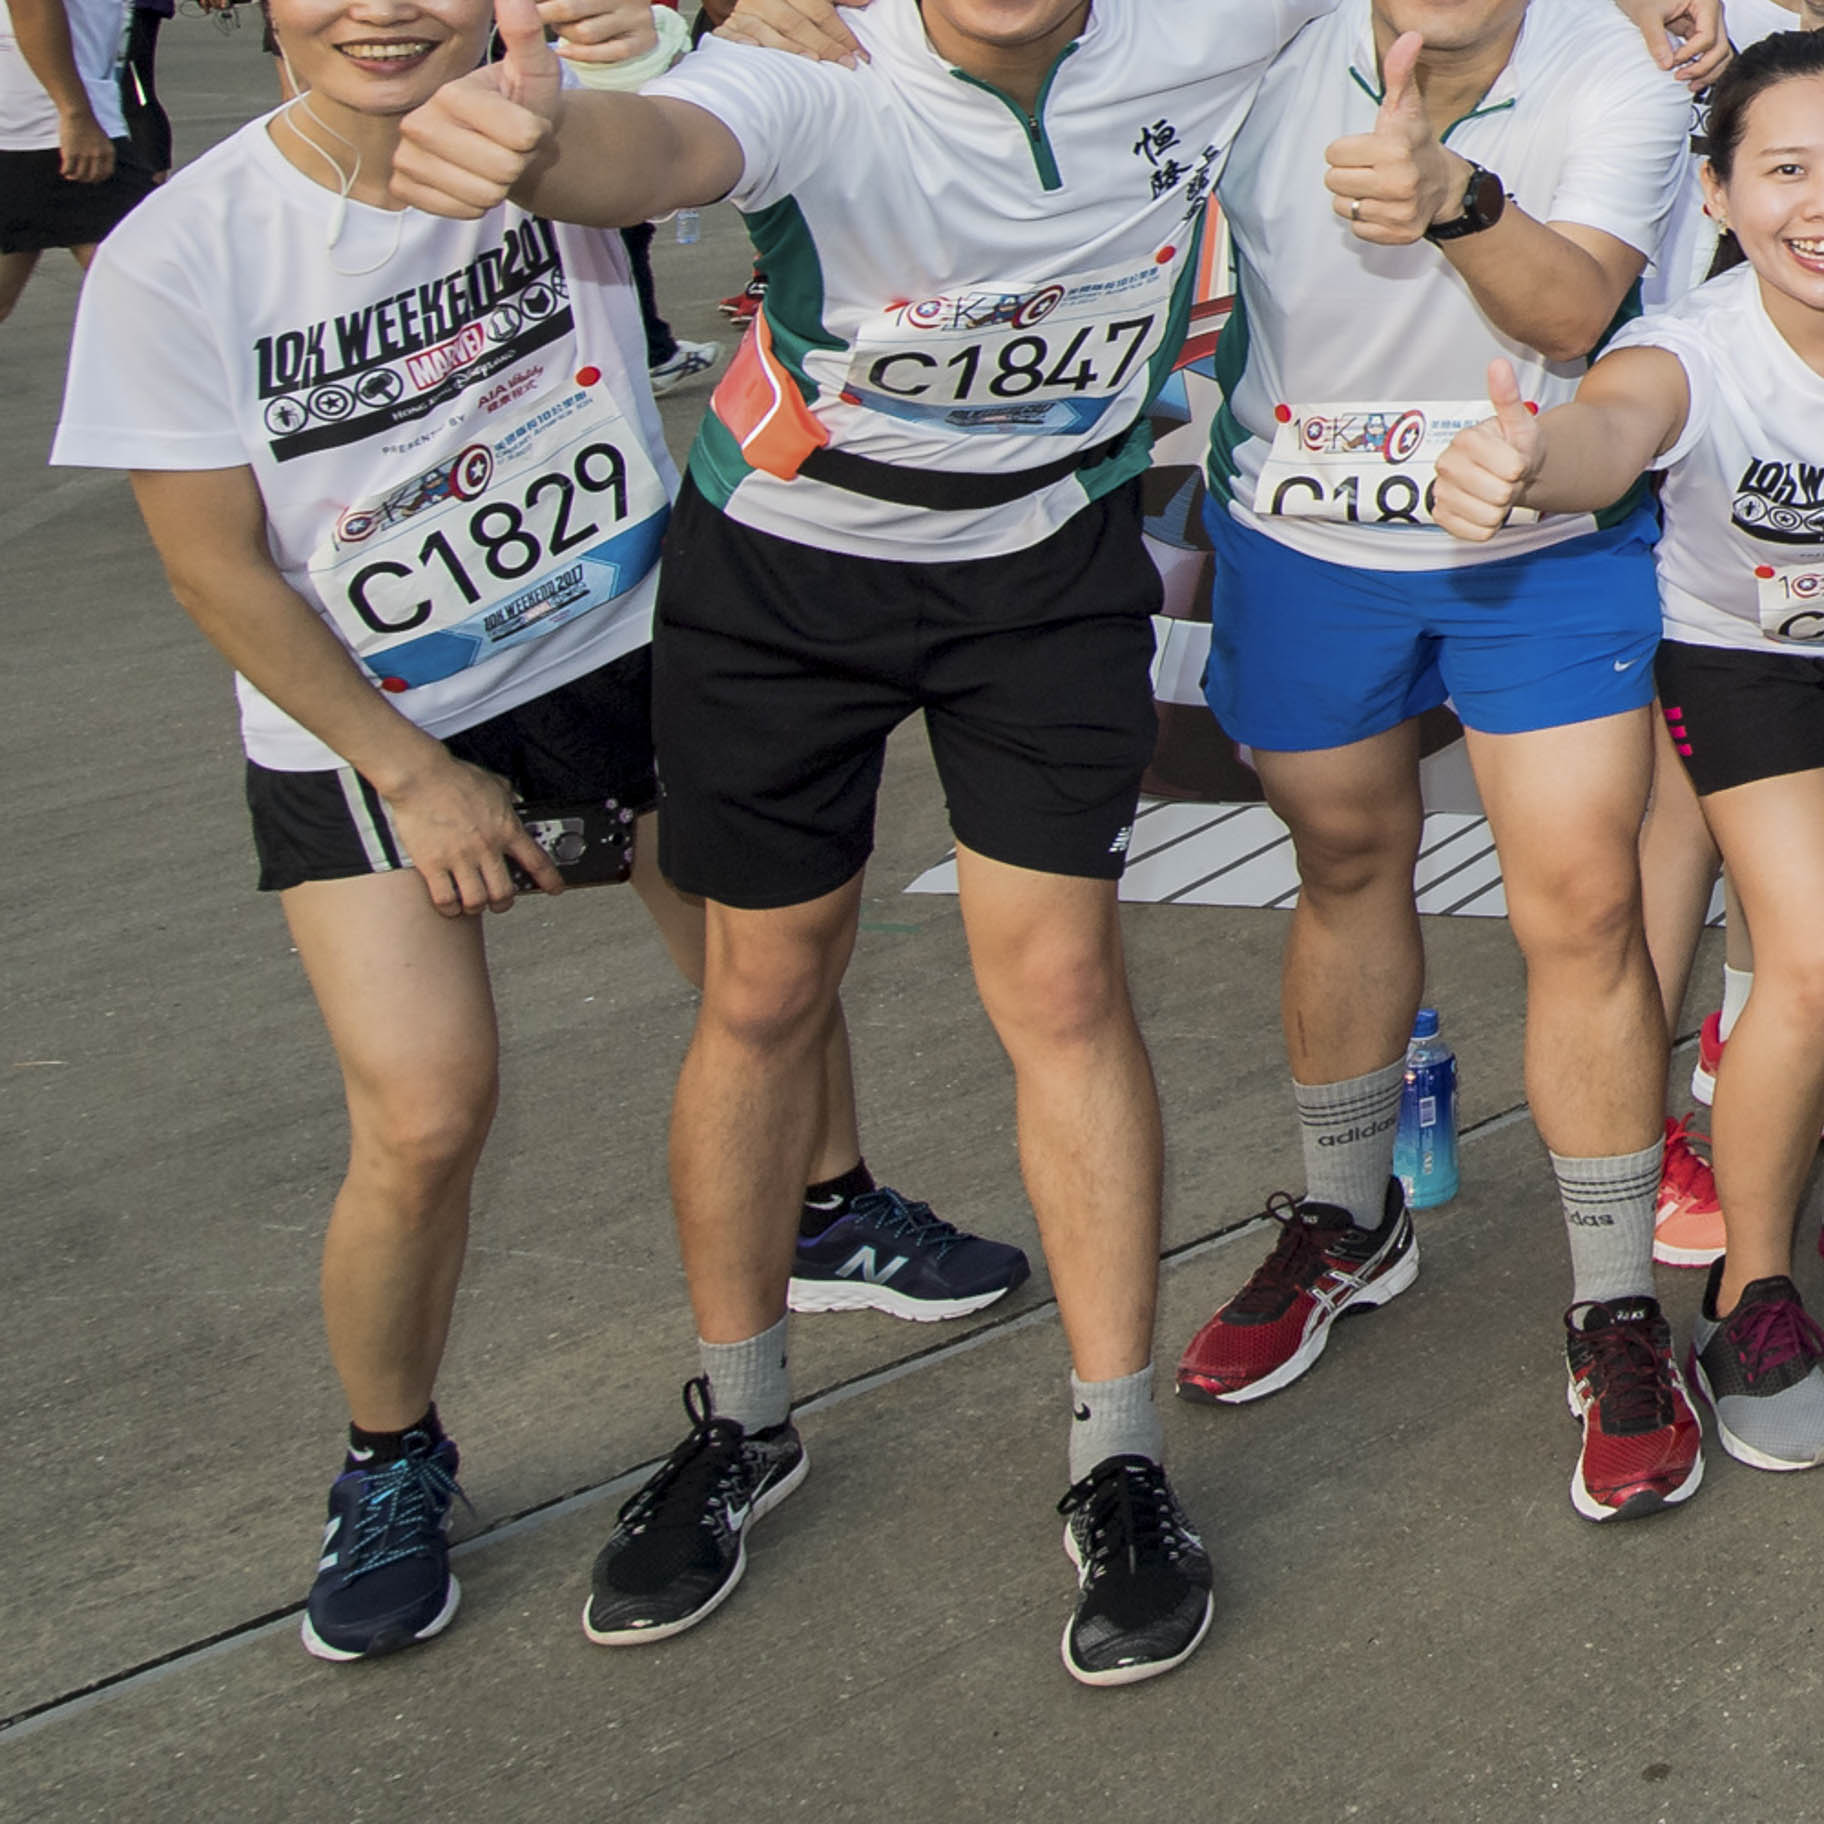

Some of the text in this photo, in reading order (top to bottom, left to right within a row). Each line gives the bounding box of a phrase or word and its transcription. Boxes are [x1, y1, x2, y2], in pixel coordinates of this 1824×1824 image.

[253, 321, 327, 400] 10K
[333, 246, 505, 374] WEEKEND
[868, 314, 1156, 401] C1847
[346, 442, 630, 635] C1829
[1271, 475, 1435, 525] C18
[1317, 1118, 1397, 1147] adida
